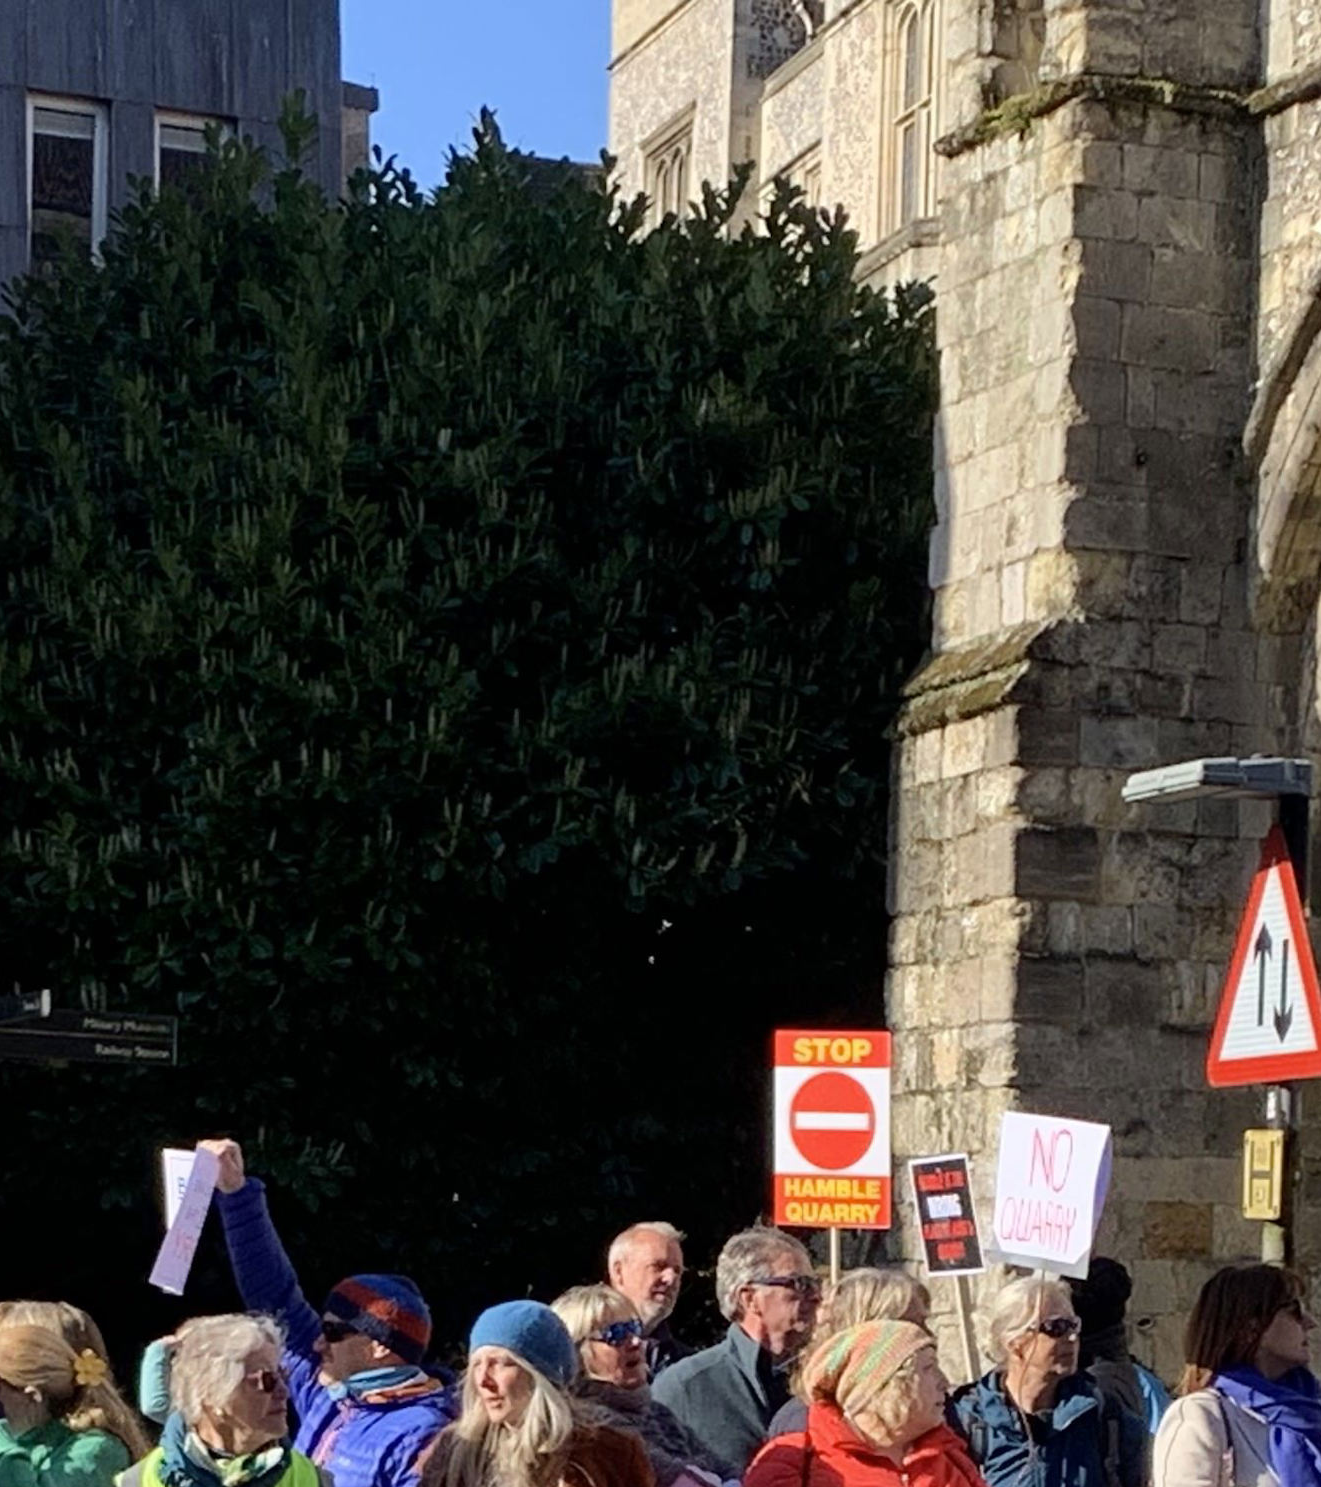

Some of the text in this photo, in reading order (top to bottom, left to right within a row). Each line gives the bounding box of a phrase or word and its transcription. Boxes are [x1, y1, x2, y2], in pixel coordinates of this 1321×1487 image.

[793, 1038, 871, 1063] STOP
[1030, 1128, 1073, 1192] NO
[784, 1179, 880, 1198] HAMBLE
[786, 1204, 880, 1224] QUARRY
[1000, 1197, 1077, 1254] QUARRY
